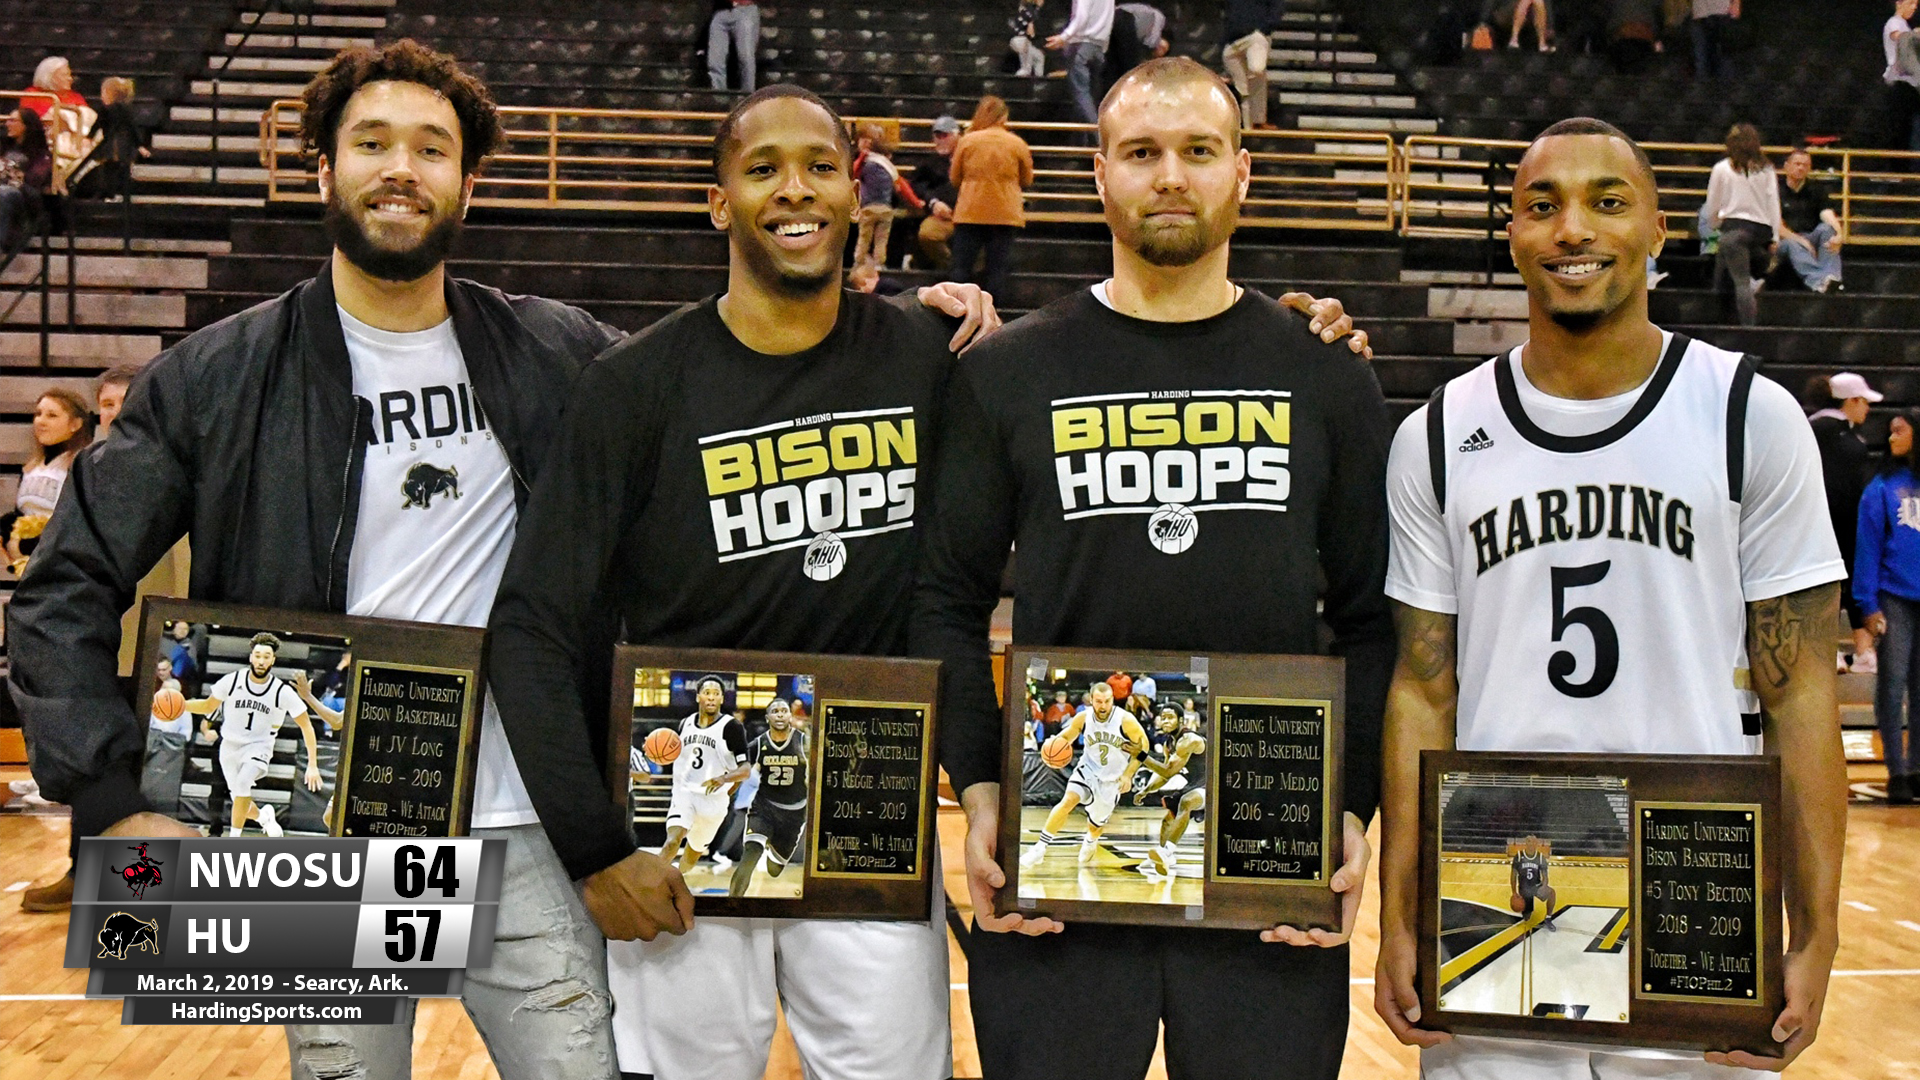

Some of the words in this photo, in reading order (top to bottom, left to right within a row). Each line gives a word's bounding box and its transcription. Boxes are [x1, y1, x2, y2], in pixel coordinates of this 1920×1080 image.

[1151, 389, 1190, 399] HARDING
[794, 412, 832, 427] HARDING
[1052, 400, 1291, 454] BISON
[387, 431, 493, 455] ISONS
[1458, 439, 1495, 453] adidas
[701, 418, 918, 496] BISON
[1054, 446, 1291, 511] HOOPS
[709, 467, 917, 553] HOOPS
[1468, 483, 1696, 578] HARDING
[1547, 559, 1620, 699] 5
[235, 699, 270, 714] HARDING
[245, 711, 254, 731] 1
[368, 735, 380, 752] #1
[386, 735, 407, 753] JV
[1099, 744, 1109, 766] 2
[691, 746, 704, 770] 3
[362, 764, 393, 785] 2018
[411, 768, 442, 788] 2019
[767, 766, 795, 786] 23
[1225, 770, 1242, 789] #2
[833, 800, 861, 820] 2014
[878, 802, 907, 820] 2019
[1231, 801, 1262, 821] 2016
[1280, 803, 1310, 823] 2019
[1646, 880, 1662, 899] #5
[1656, 914, 1688, 934] 2018
[1708, 916, 1742, 936] 2019
